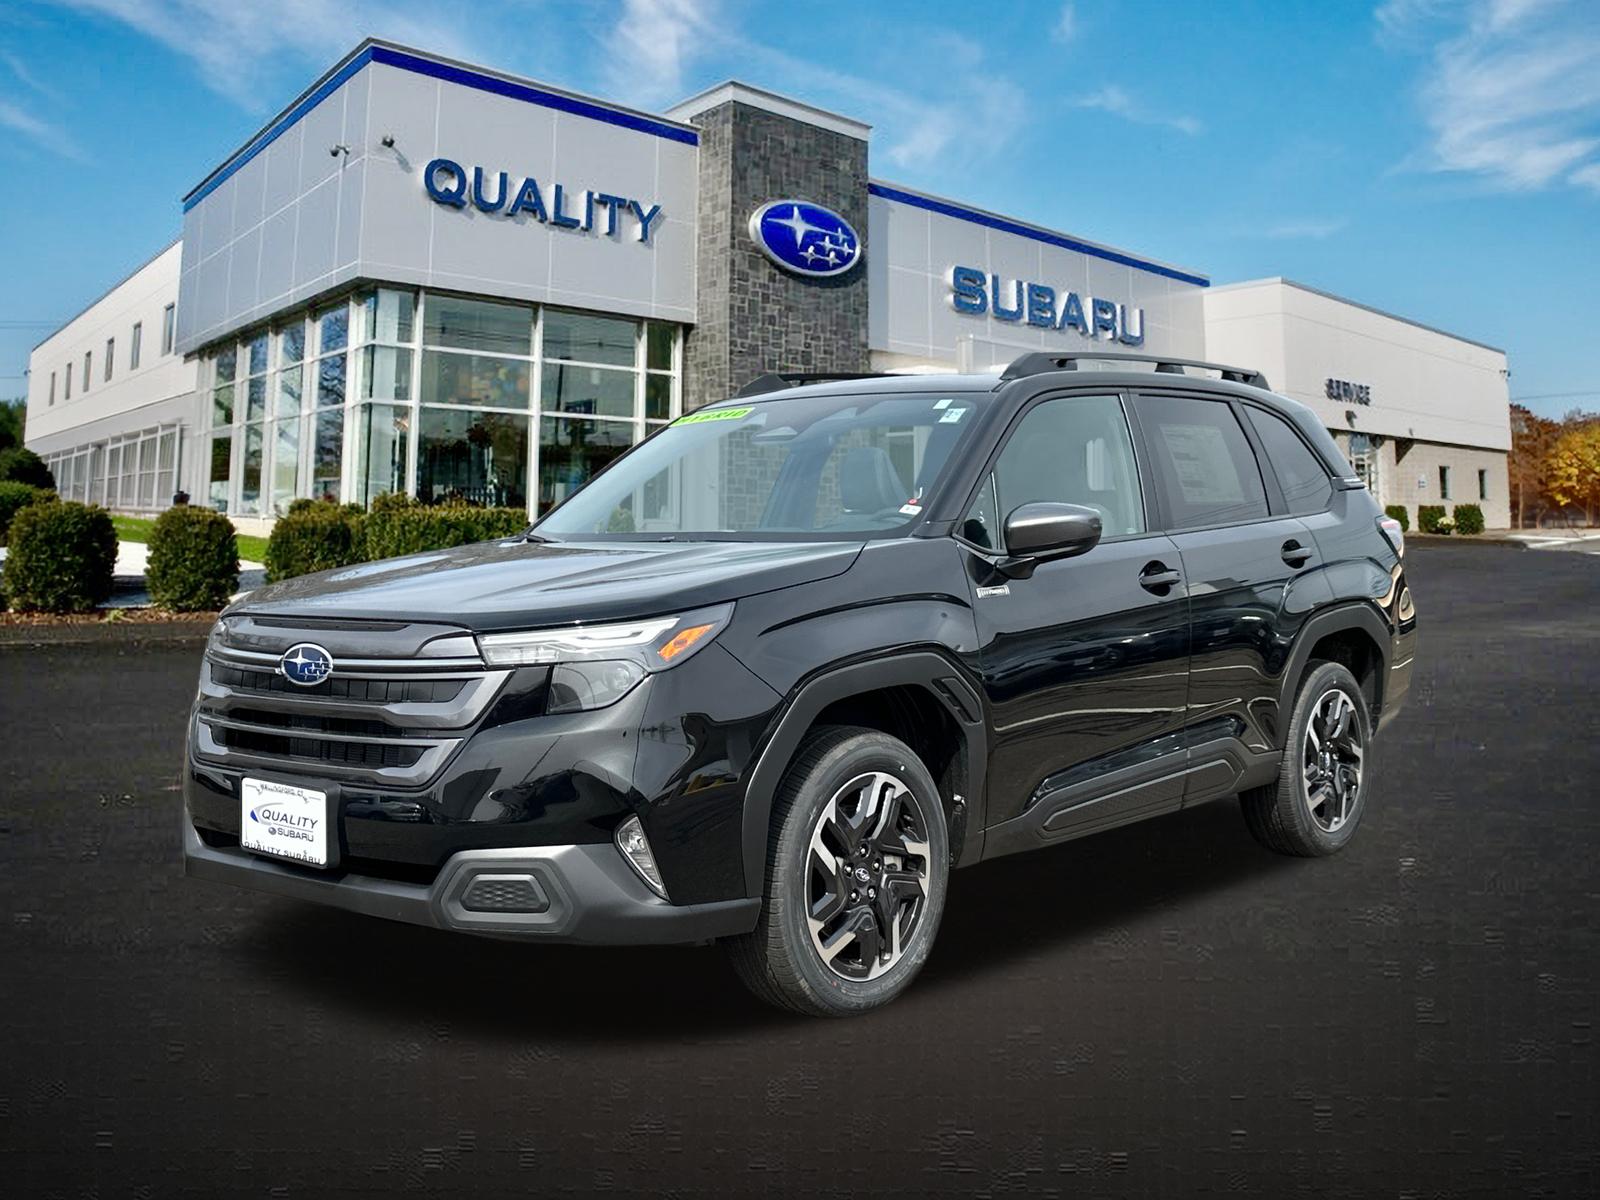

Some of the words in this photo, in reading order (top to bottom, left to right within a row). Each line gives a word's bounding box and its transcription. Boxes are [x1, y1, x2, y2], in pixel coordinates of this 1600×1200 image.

[424, 158, 662, 242] QUALITY
[951, 265, 1145, 347] SUBARU
[262, 809, 318, 829] QUALITY
[277, 827, 314, 842] SUBARU
